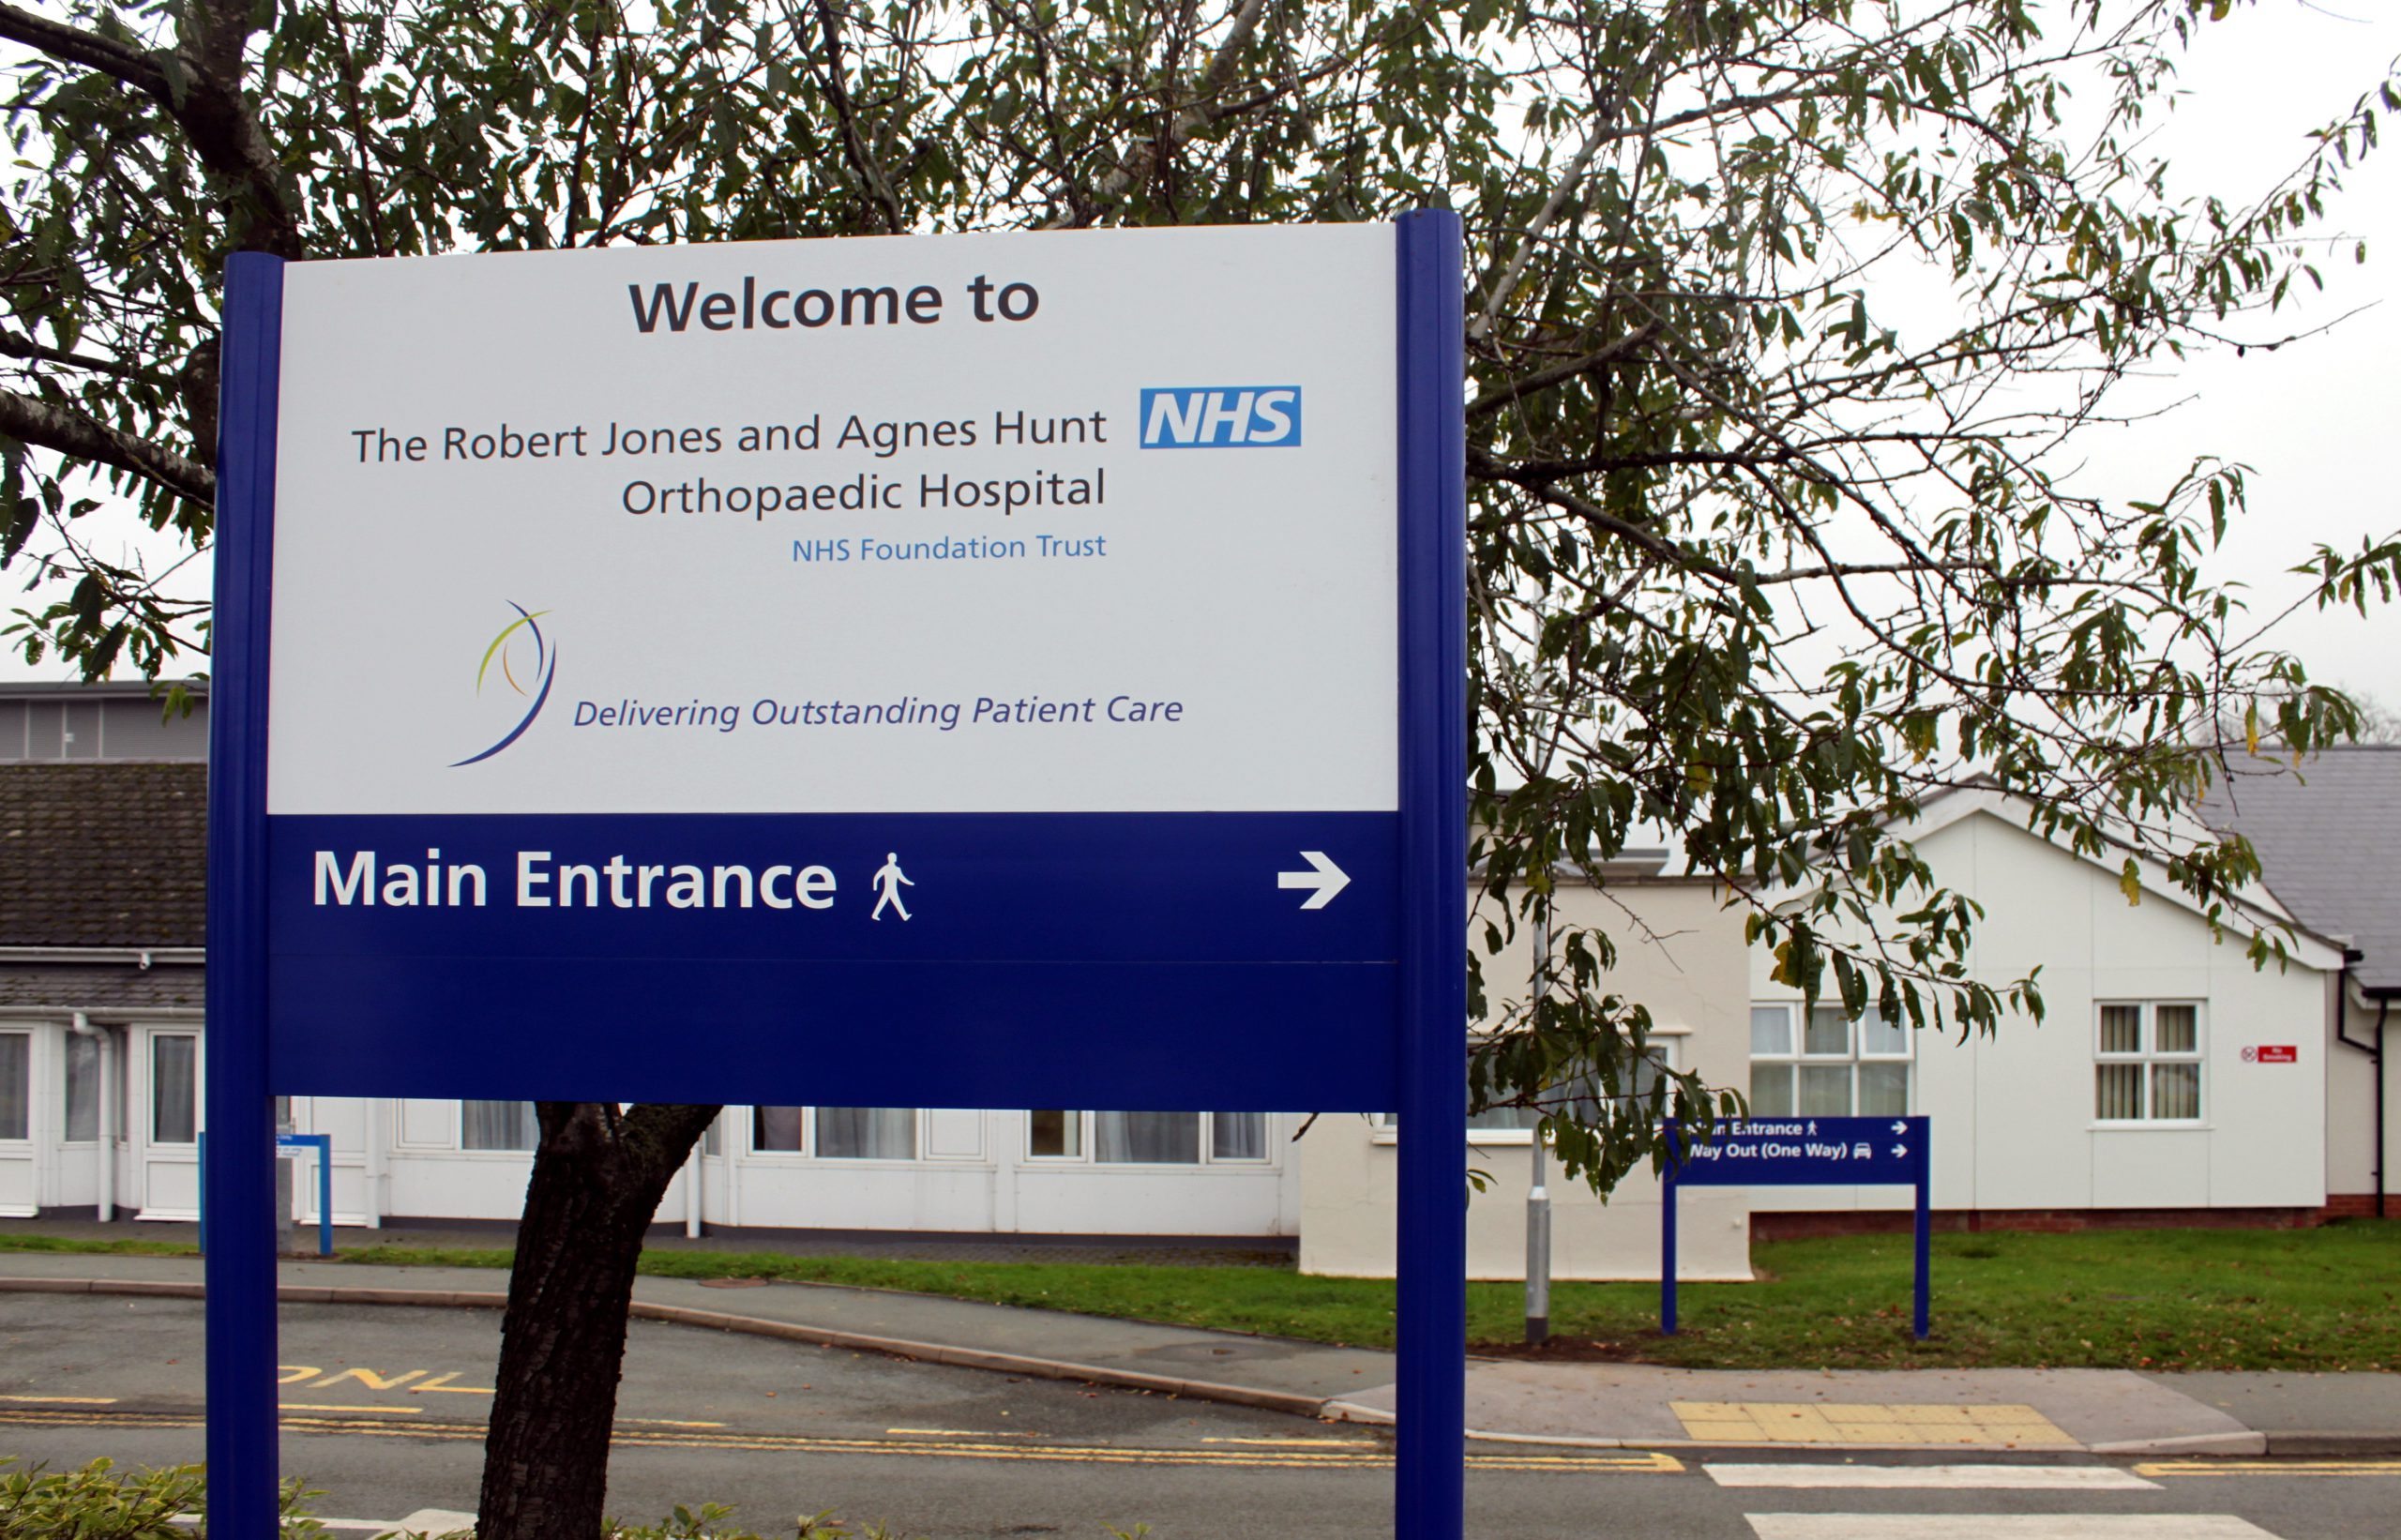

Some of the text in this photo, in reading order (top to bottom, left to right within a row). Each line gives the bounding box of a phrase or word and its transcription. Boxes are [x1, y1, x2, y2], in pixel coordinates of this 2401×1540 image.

[628, 275, 1038, 333] Welcome to
[352, 411, 1107, 462] The Robert Jones and Agnes Hunt
[1144, 390, 1296, 445] NHS
[623, 469, 1103, 521] Orthopaedic Hospital
[793, 536, 1106, 562] NHS Foundation Trust
[574, 696, 1183, 732] Delivering Outstanding Patient Care
[315, 848, 837, 909] Main Entrance
[1726, 1143, 1758, 1157] Out
[1761, 1142, 1801, 1159] (One
[1805, 1142, 1848, 1160] Way)
